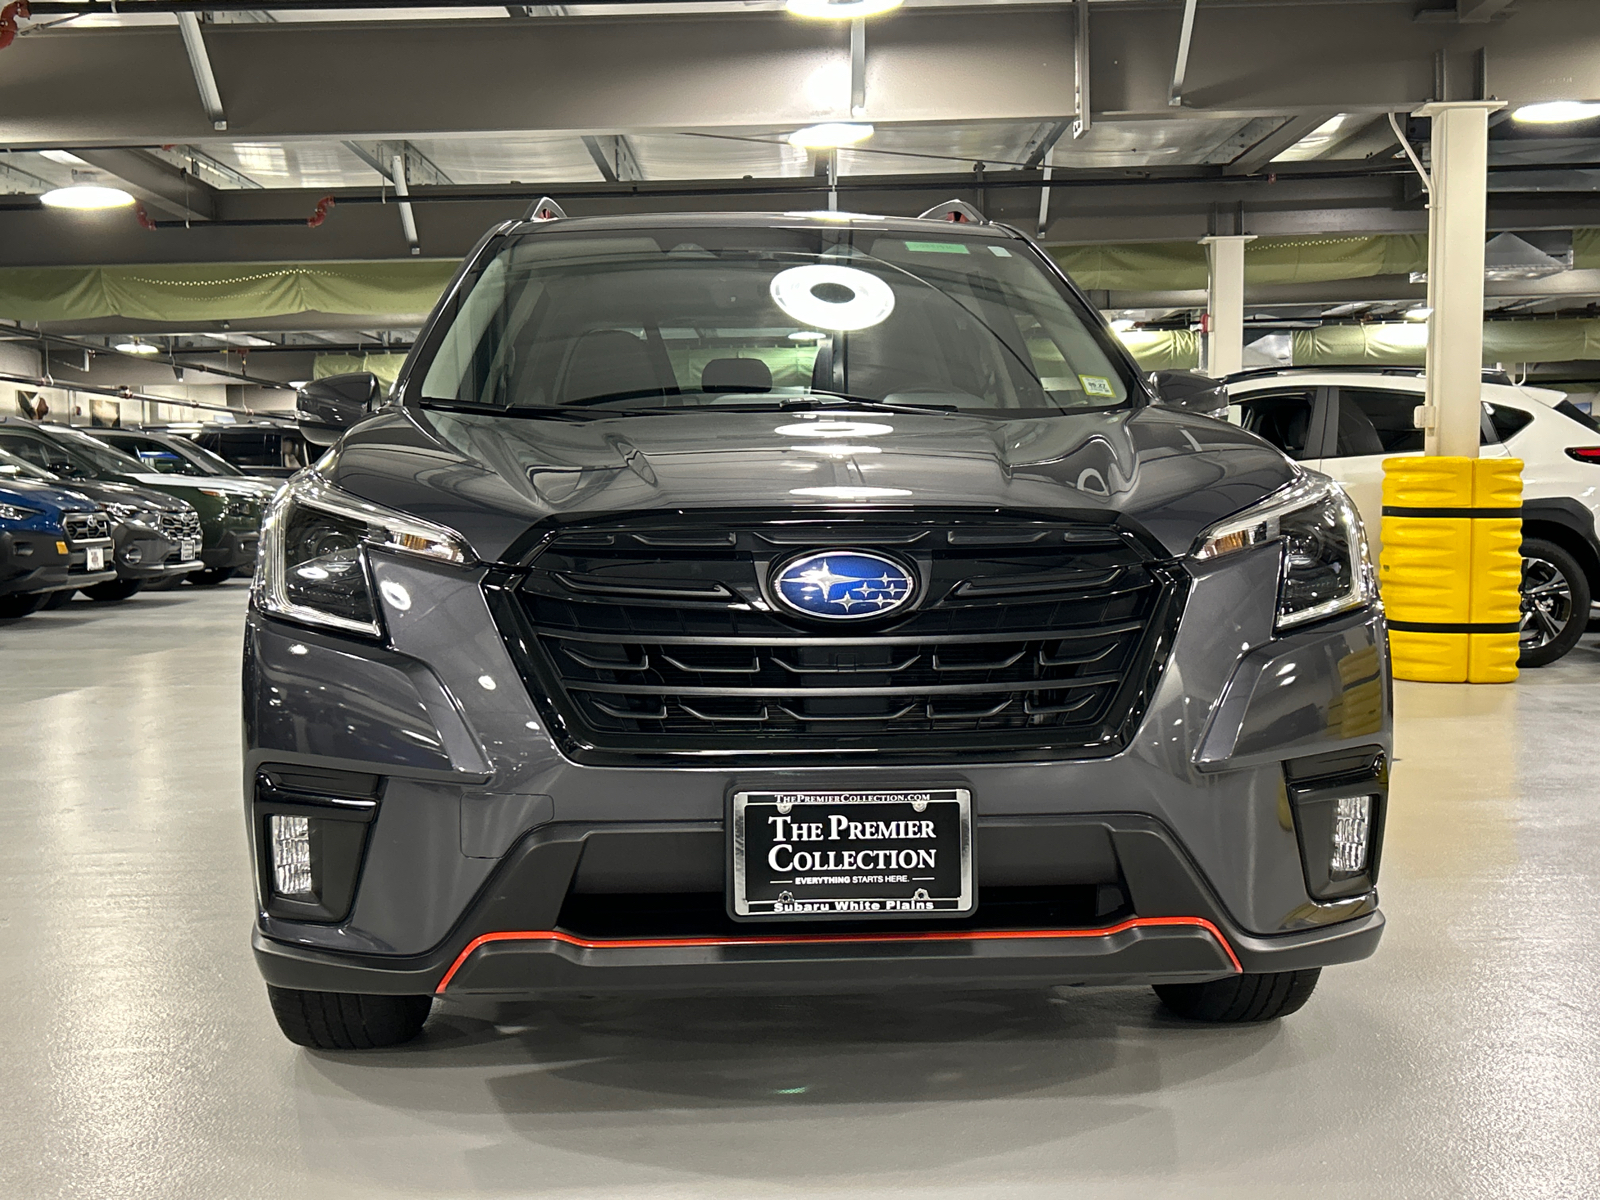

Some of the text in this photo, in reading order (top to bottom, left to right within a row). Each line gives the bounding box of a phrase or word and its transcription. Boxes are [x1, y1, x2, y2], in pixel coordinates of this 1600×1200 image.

[768, 814, 937, 842] THE PREMIER
[768, 843, 937, 872] COLLECTION
[794, 875, 910, 885] EVERYTHING STARTS HERE.
[773, 900, 934, 913] Subaru White Plains
